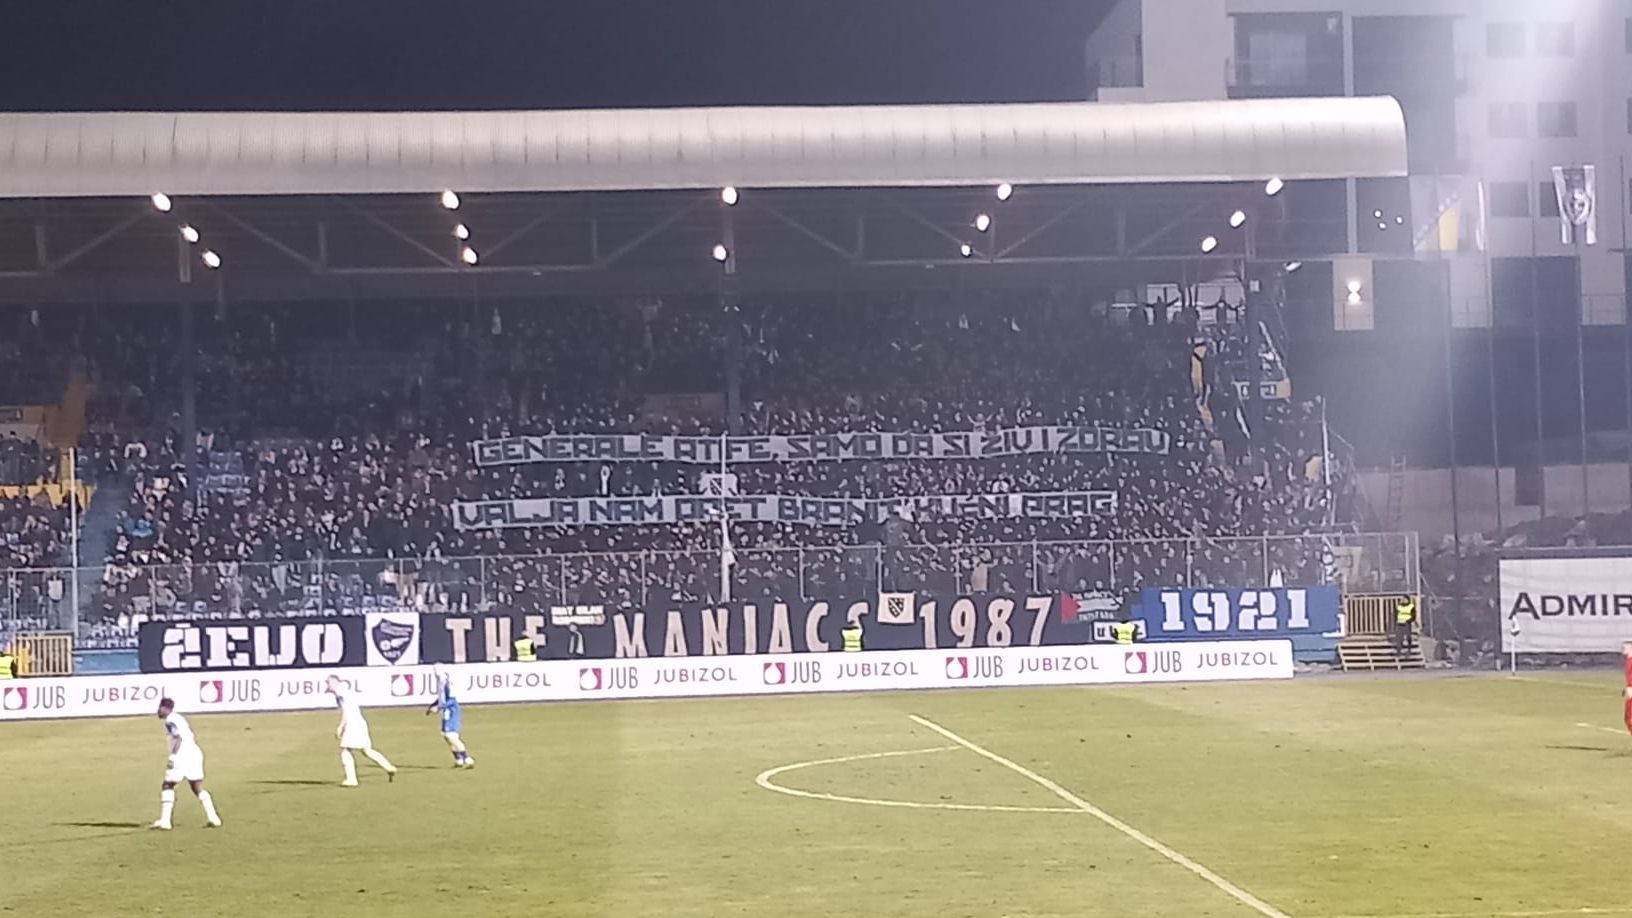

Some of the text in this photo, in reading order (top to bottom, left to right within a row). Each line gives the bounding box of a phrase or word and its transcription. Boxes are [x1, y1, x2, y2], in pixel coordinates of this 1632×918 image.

[479, 437, 664, 462] GENERALE
[788, 435, 881, 459] SAMO
[892, 434, 933, 455] DA
[943, 435, 970, 456] SI
[458, 500, 578, 524] VALJA
[590, 499, 663, 521] NAM
[1161, 589, 1310, 632] 1921
[919, 597, 1053, 648] 1987
[791, 661, 918, 684] JUB JUBIZOL
[973, 655, 1099, 678] JUB JUBIZOL
[1152, 651, 1278, 673] JUB JUBIZOL
[467, 673, 551, 690] JUBIZOL
[608, 667, 737, 689] JUB JUBIZOL
[33, 686, 65, 709] JUB
[229, 679, 260, 702] JUB
